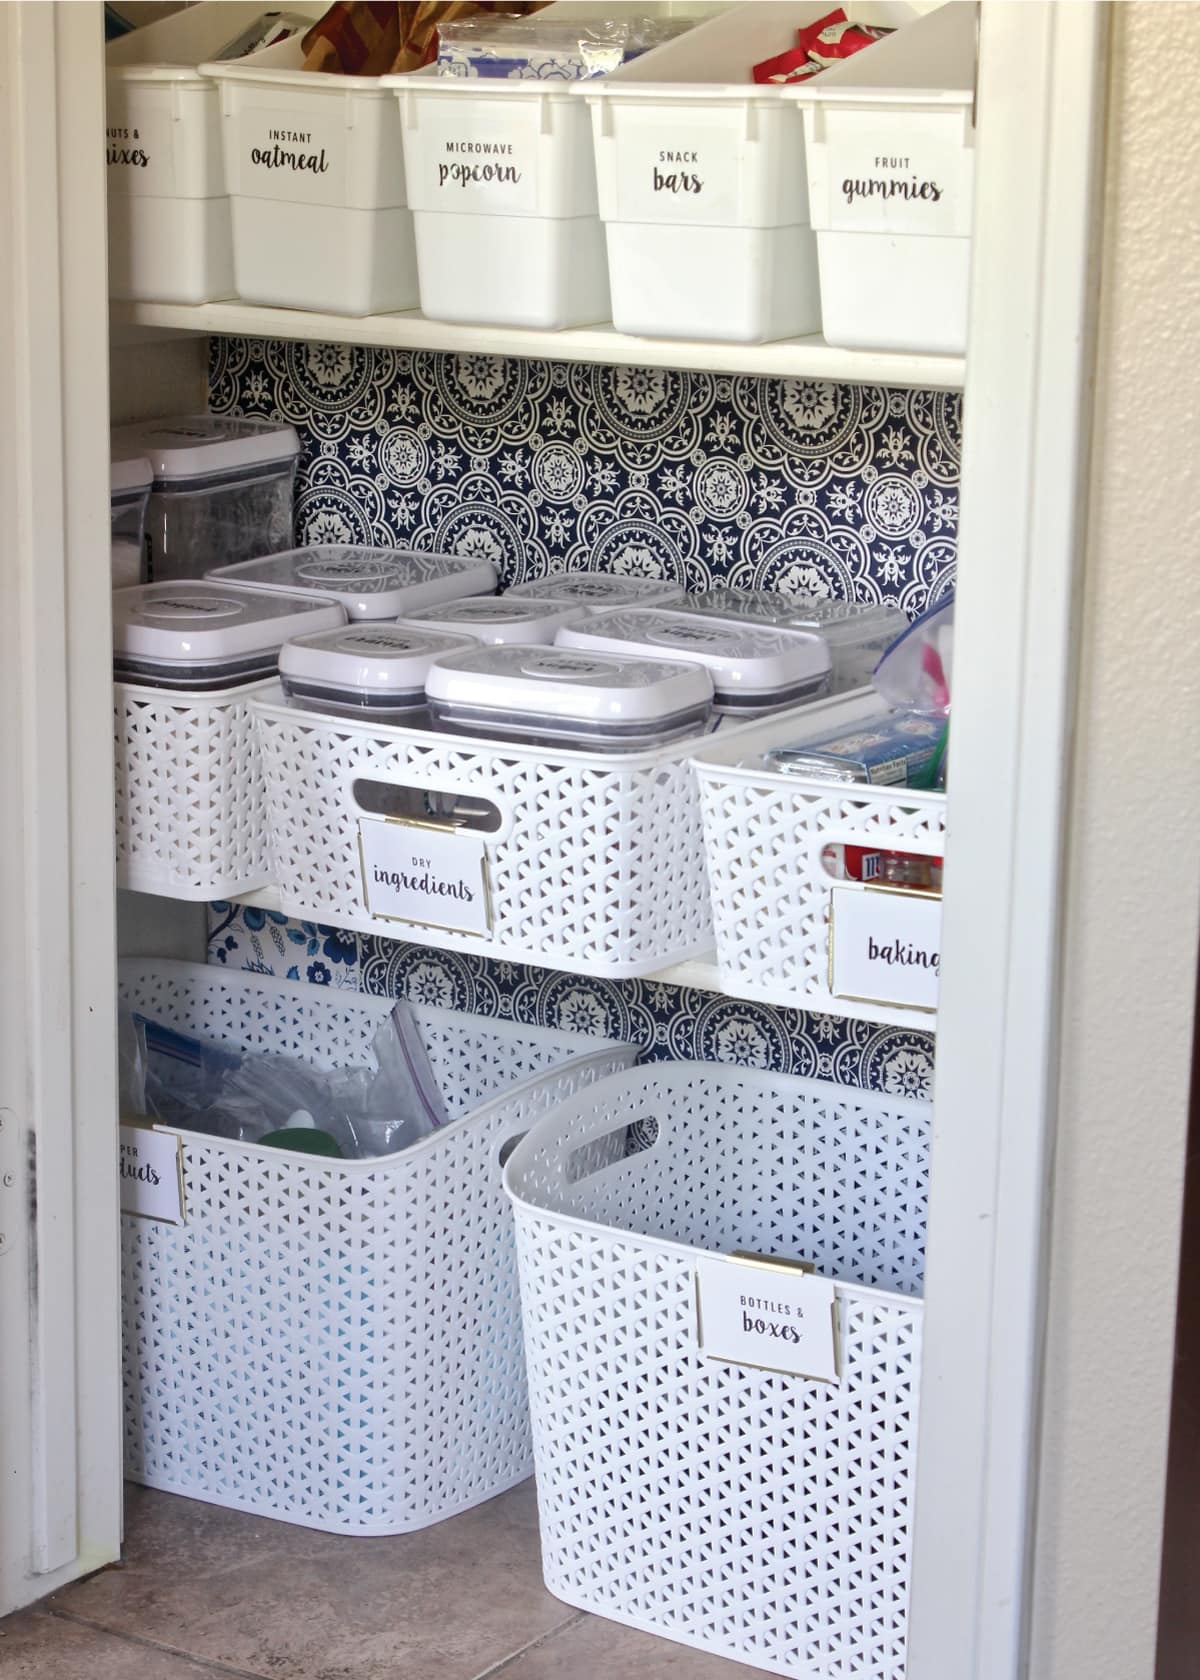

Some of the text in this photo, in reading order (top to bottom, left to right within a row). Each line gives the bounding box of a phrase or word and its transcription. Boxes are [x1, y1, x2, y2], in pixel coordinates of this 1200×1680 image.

[269, 129, 312, 144] INSTANT
[446, 141, 513, 155] MICROWAVE
[251, 144, 330, 174] oatmeal
[659, 150, 698, 163] SNACK
[875, 156, 911, 169] FRUIT
[439, 162, 522, 188] popcorn
[653, 166, 705, 194] bars
[842, 175, 944, 205] gummies
[412, 856, 432, 869] DRY
[373, 864, 476, 903] ingredients
[868, 935, 941, 978] baking
[740, 1295, 804, 1319] BOTTLES &
[743, 1310, 803, 1345] boxes
